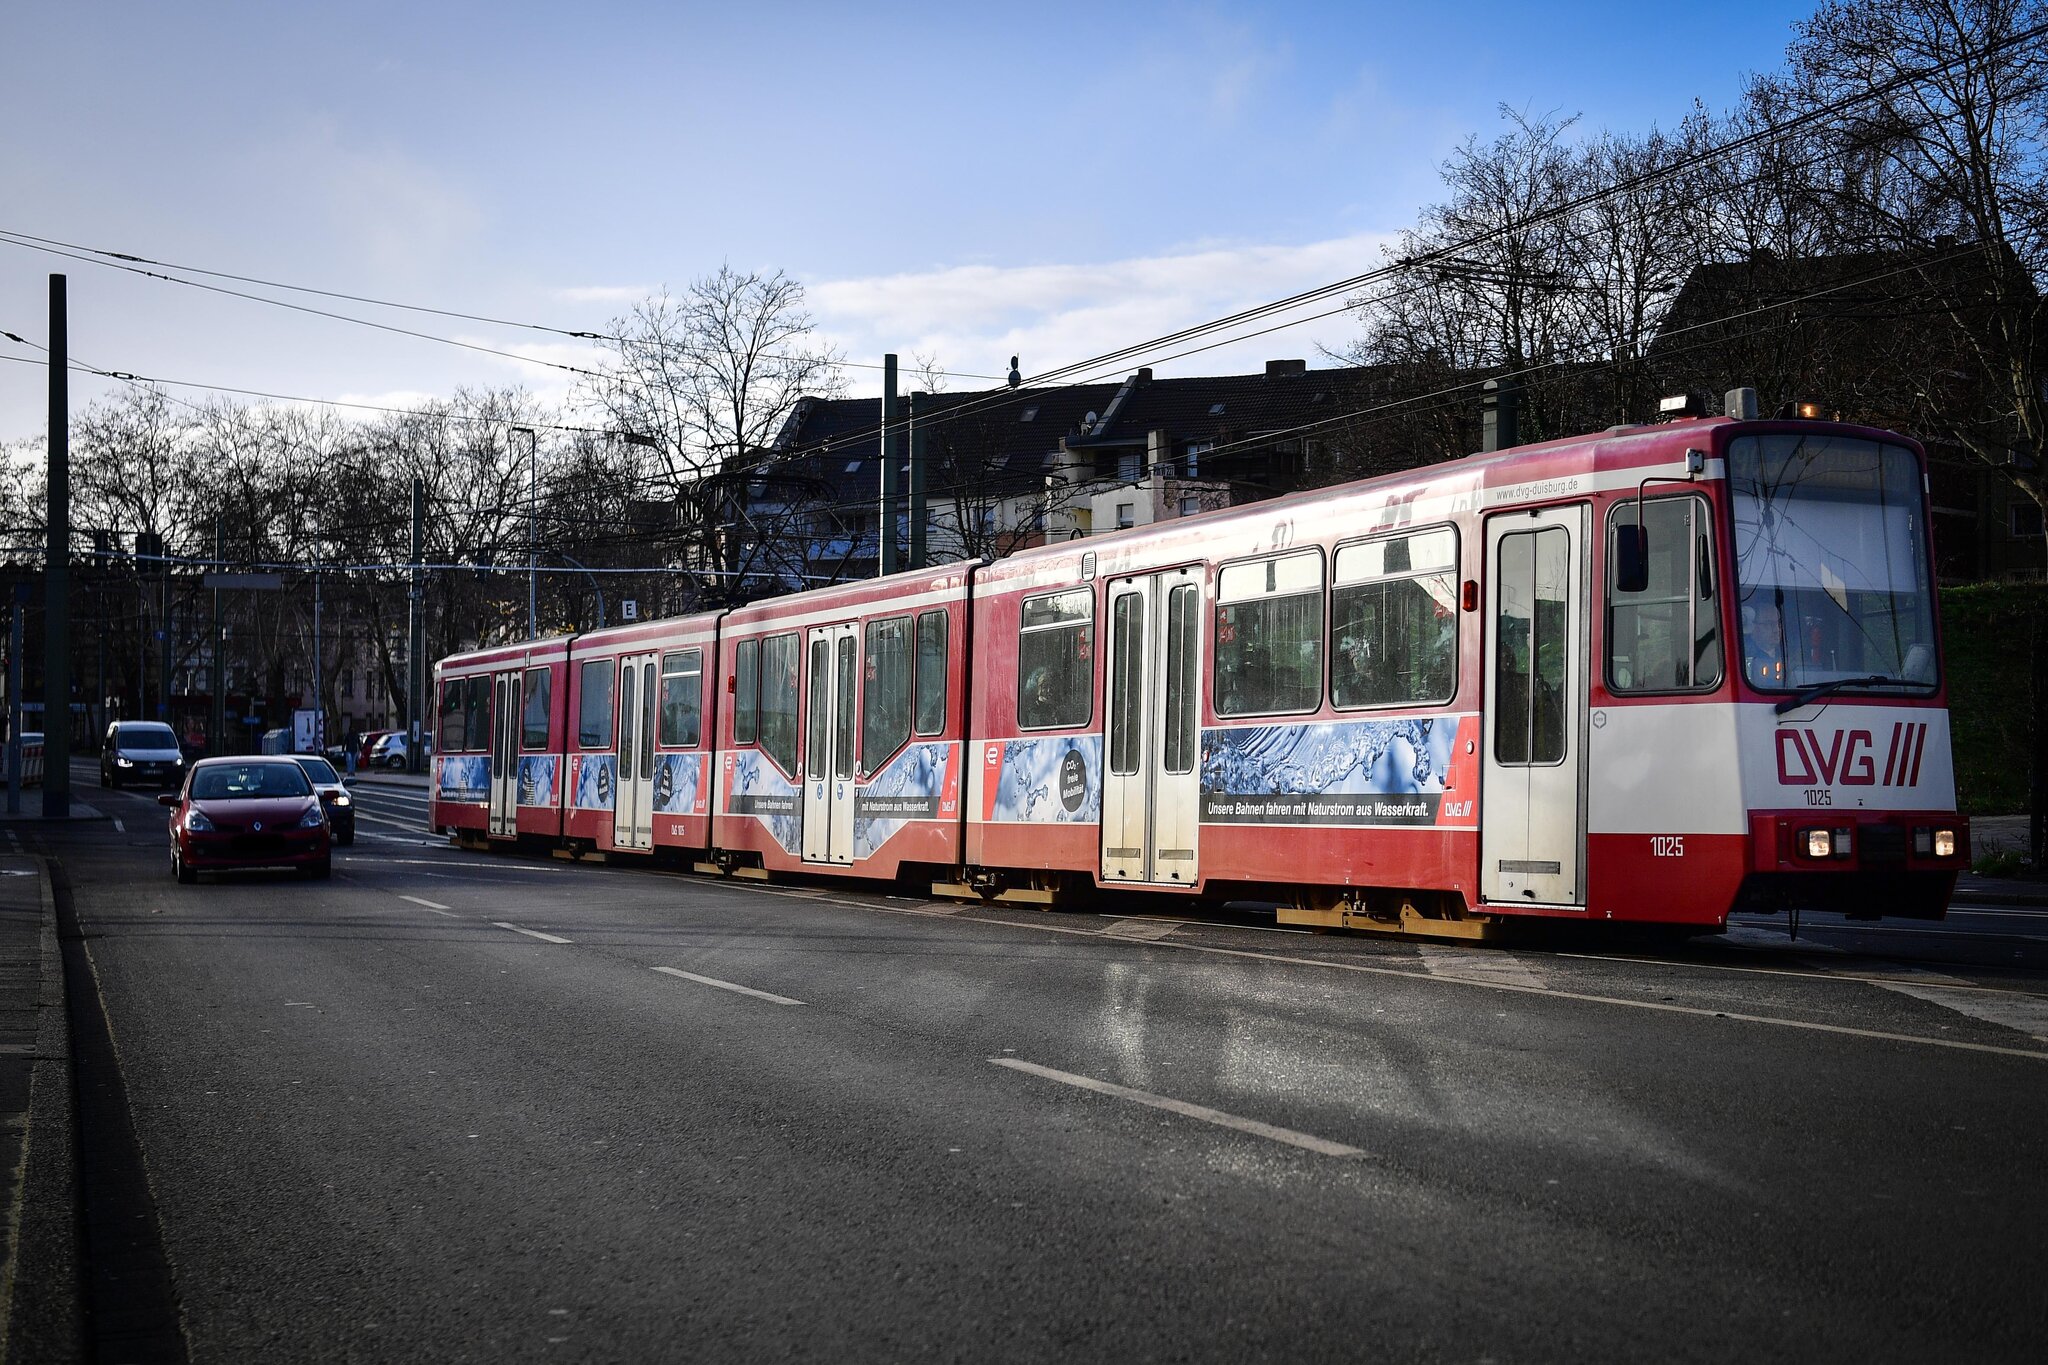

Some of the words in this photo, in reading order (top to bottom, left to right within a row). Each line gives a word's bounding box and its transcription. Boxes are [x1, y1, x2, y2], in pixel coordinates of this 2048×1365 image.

[1496, 478, 1578, 500] www.dvg-duisburg.de
[626, 604, 632, 616] E
[1775, 729, 1876, 786] DVG
[1803, 789, 1832, 806] 1025
[1208, 802, 1234, 815] Unsere
[1235, 802, 1264, 816] Bahnen
[1265, 802, 1291, 816] fahren
[1293, 802, 1306, 816] mit
[1307, 802, 1354, 816] Naturstrom
[1356, 806, 1372, 816] aus
[1374, 802, 1429, 817] Wasserkraft.
[1650, 836, 1684, 857] 1025
